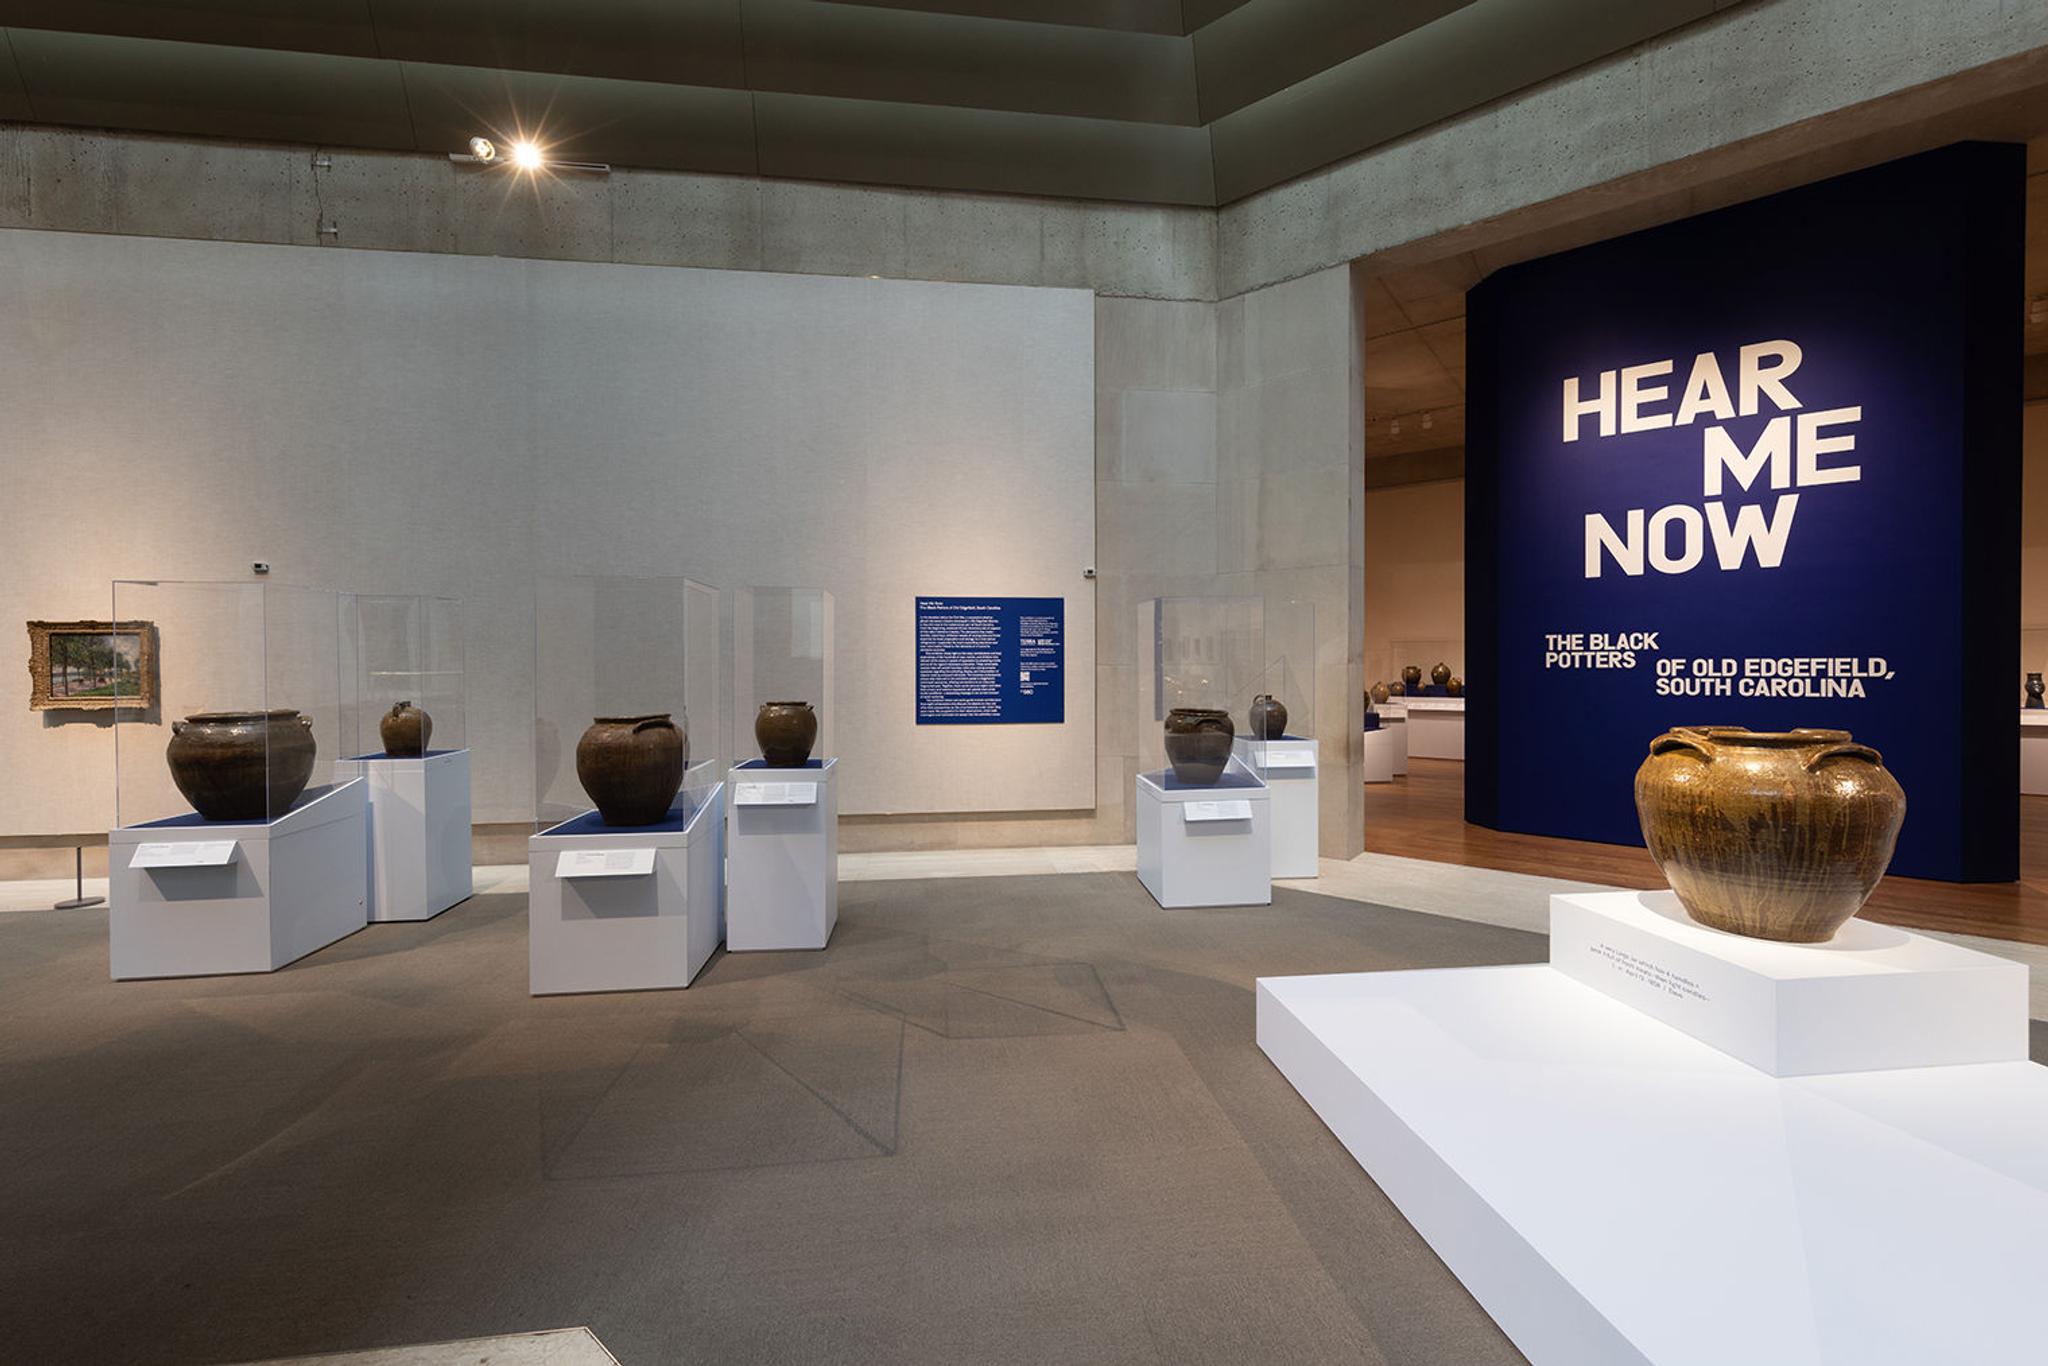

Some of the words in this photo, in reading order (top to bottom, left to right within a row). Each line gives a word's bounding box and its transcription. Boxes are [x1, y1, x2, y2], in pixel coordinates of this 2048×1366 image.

[1562, 340, 1804, 443] HEAR
[1703, 405, 1862, 497] ME
[1584, 493, 1801, 579] NOW
[1545, 633, 1584, 651] THE
[1589, 631, 1660, 651] BLACK
[1545, 650, 1637, 669] POTTERS
[1655, 658, 1687, 677] OF
[1692, 658, 1738, 677] OLD
[1744, 657, 1895, 680] EDGEFIELD,
[1655, 677, 1732, 696] SOUTH
[1738, 677, 1866, 698] CAROLINA
